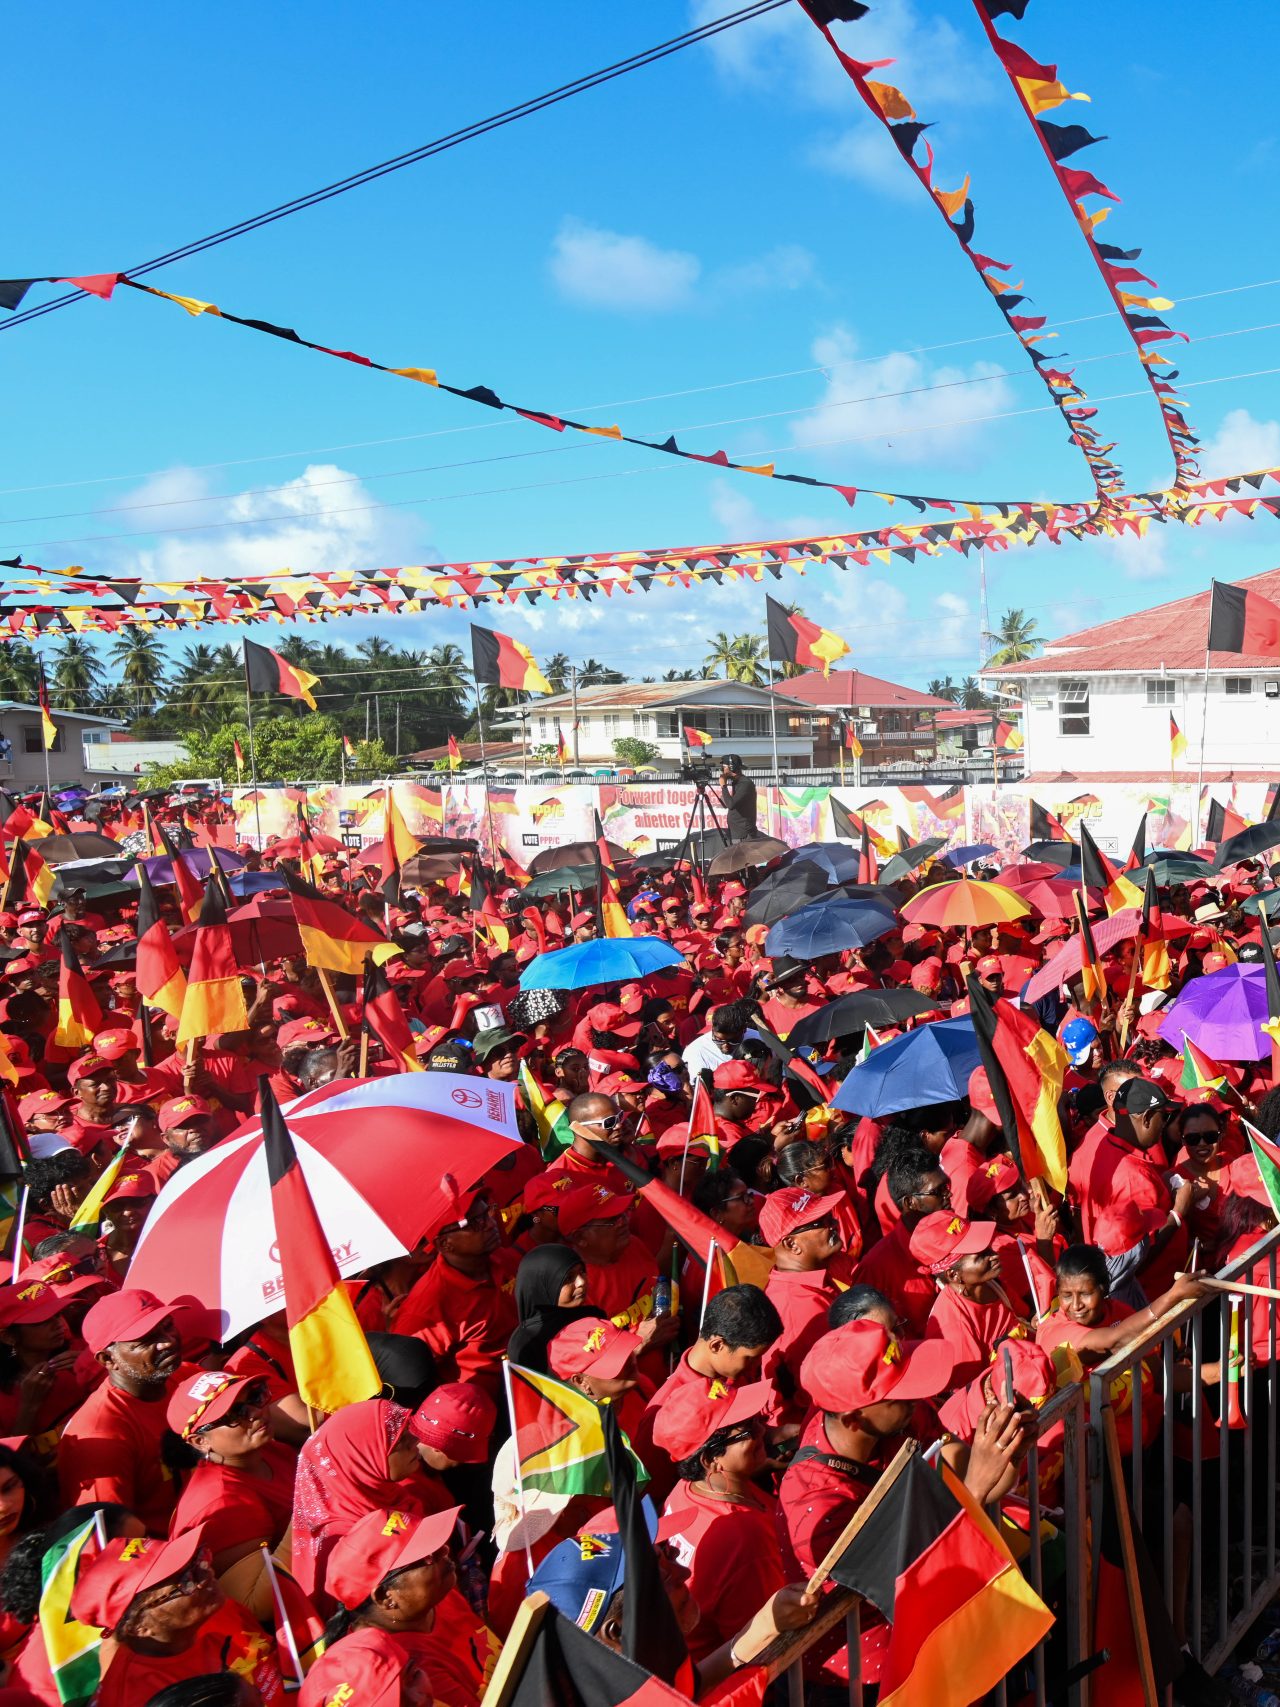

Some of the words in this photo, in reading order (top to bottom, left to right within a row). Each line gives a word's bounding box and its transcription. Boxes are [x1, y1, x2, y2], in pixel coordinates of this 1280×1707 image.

[616, 787, 661, 806] Forward
[1052, 802, 1103, 818] PPP/C
[523, 835, 538, 846] VOTE
[486, 1088, 502, 1122] BEHARRY
[262, 1239, 352, 1298] BERY
